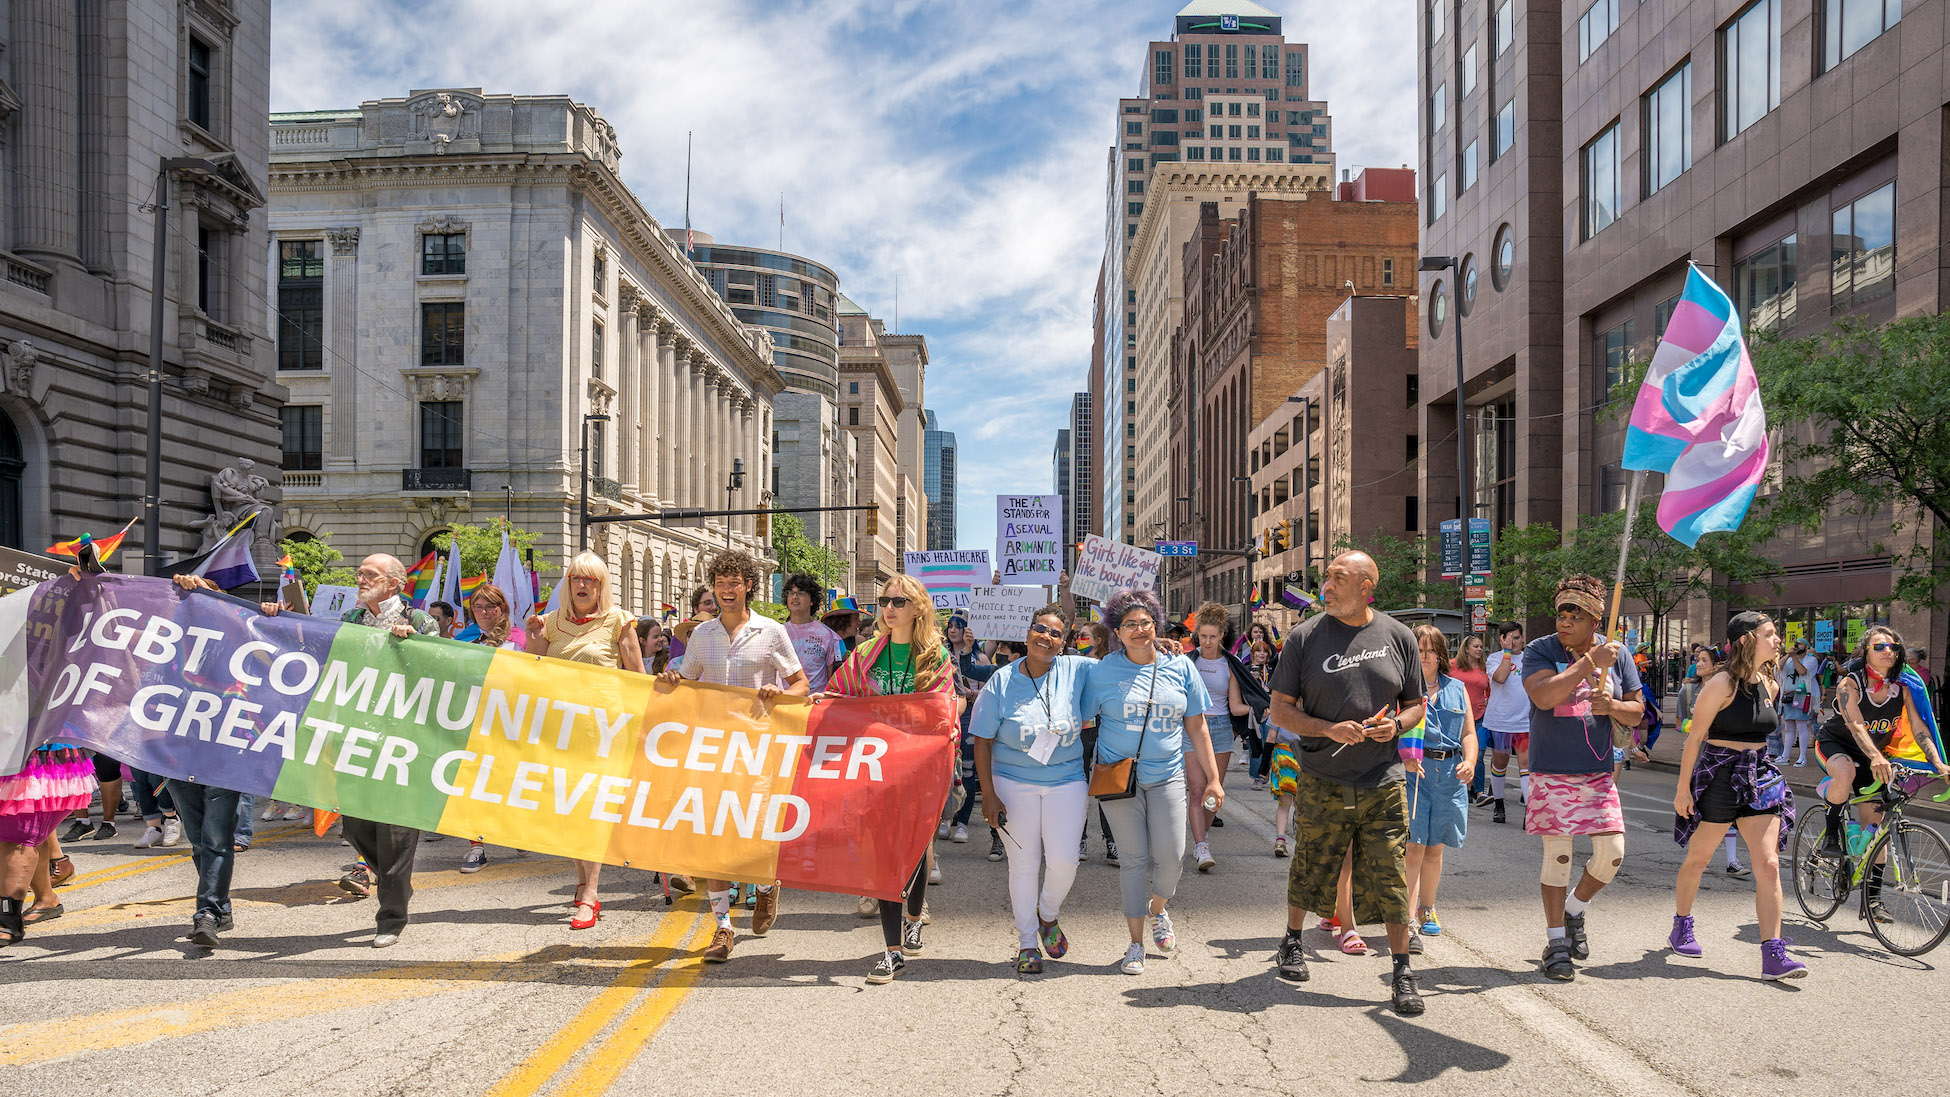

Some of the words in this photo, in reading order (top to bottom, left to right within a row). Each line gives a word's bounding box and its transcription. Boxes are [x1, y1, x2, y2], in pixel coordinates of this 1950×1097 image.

[1009, 498, 1028, 508] THE
[1003, 508, 1035, 519] STANDS
[1035, 509, 1050, 519] FOR
[1005, 523, 1053, 536] ASEXUAL
[1004, 541, 1057, 555] AROMANTIC
[1160, 546, 1168, 554] E.
[1172, 546, 1178, 554] 3
[1182, 546, 1192, 554] St
[905, 552, 930, 563] TRANS
[934, 551, 987, 563] HEALTHCARE
[1087, 537, 1116, 563] Girls
[1118, 546, 1138, 569] like
[1136, 557, 1160, 577] girls
[16, 563, 60, 581] State
[1004, 559, 1055, 573] AGENDER
[1077, 557, 1096, 577] like
[1099, 564, 1125, 587] boys
[974, 587, 996, 597] THE
[1001, 589, 1024, 597] ONLY
[970, 602, 1005, 611] CHOICE
[983, 621, 1029, 639] MYSE
[1322, 645, 1388, 673] Cleveland
[68, 608, 225, 672] LGBT
[228, 640, 634, 758] COMMUNITY
[644, 721, 889, 782] CENTER
[1123, 703, 1184, 719] PRIDE
[1020, 716, 1080, 742] PRDE
[1148, 717, 1180, 733] CLE
[47, 662, 122, 710] OF
[129, 684, 419, 786] GREATER
[430, 749, 811, 843] CLEVELAND
